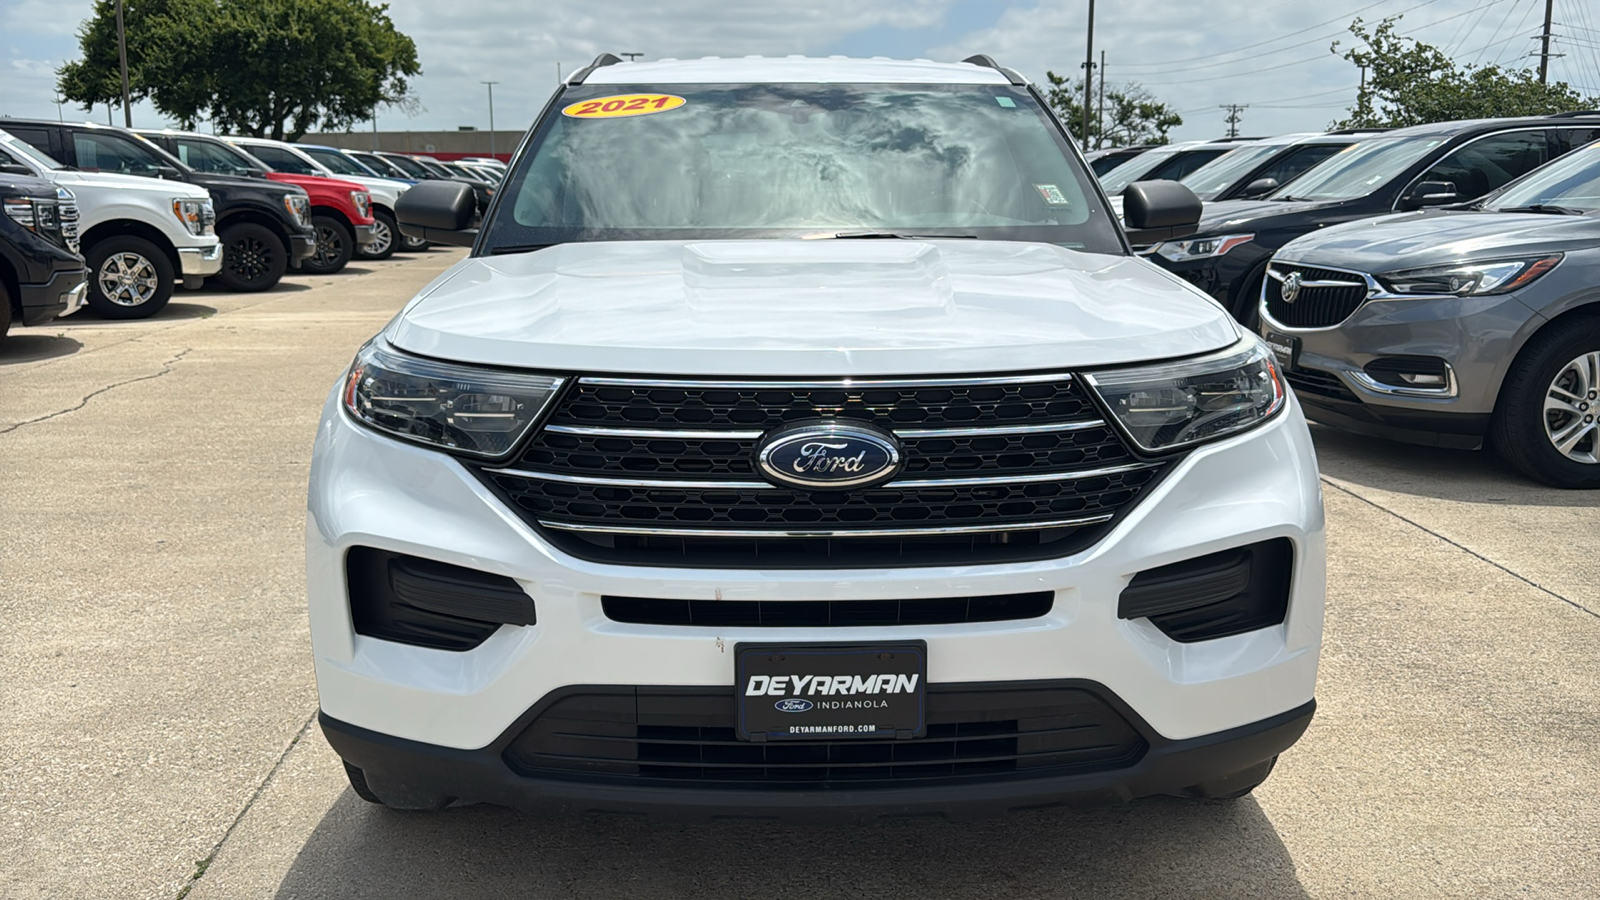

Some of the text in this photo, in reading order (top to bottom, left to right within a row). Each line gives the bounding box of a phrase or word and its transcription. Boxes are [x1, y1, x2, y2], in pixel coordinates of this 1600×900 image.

[575, 97, 670, 115] 2021
[793, 442, 866, 472] Ford
[745, 674, 919, 696] DEYARMAN
[782, 700, 888, 710] Ford INDIANOLA
[789, 725, 876, 734] DEYARMANFORD.COM
